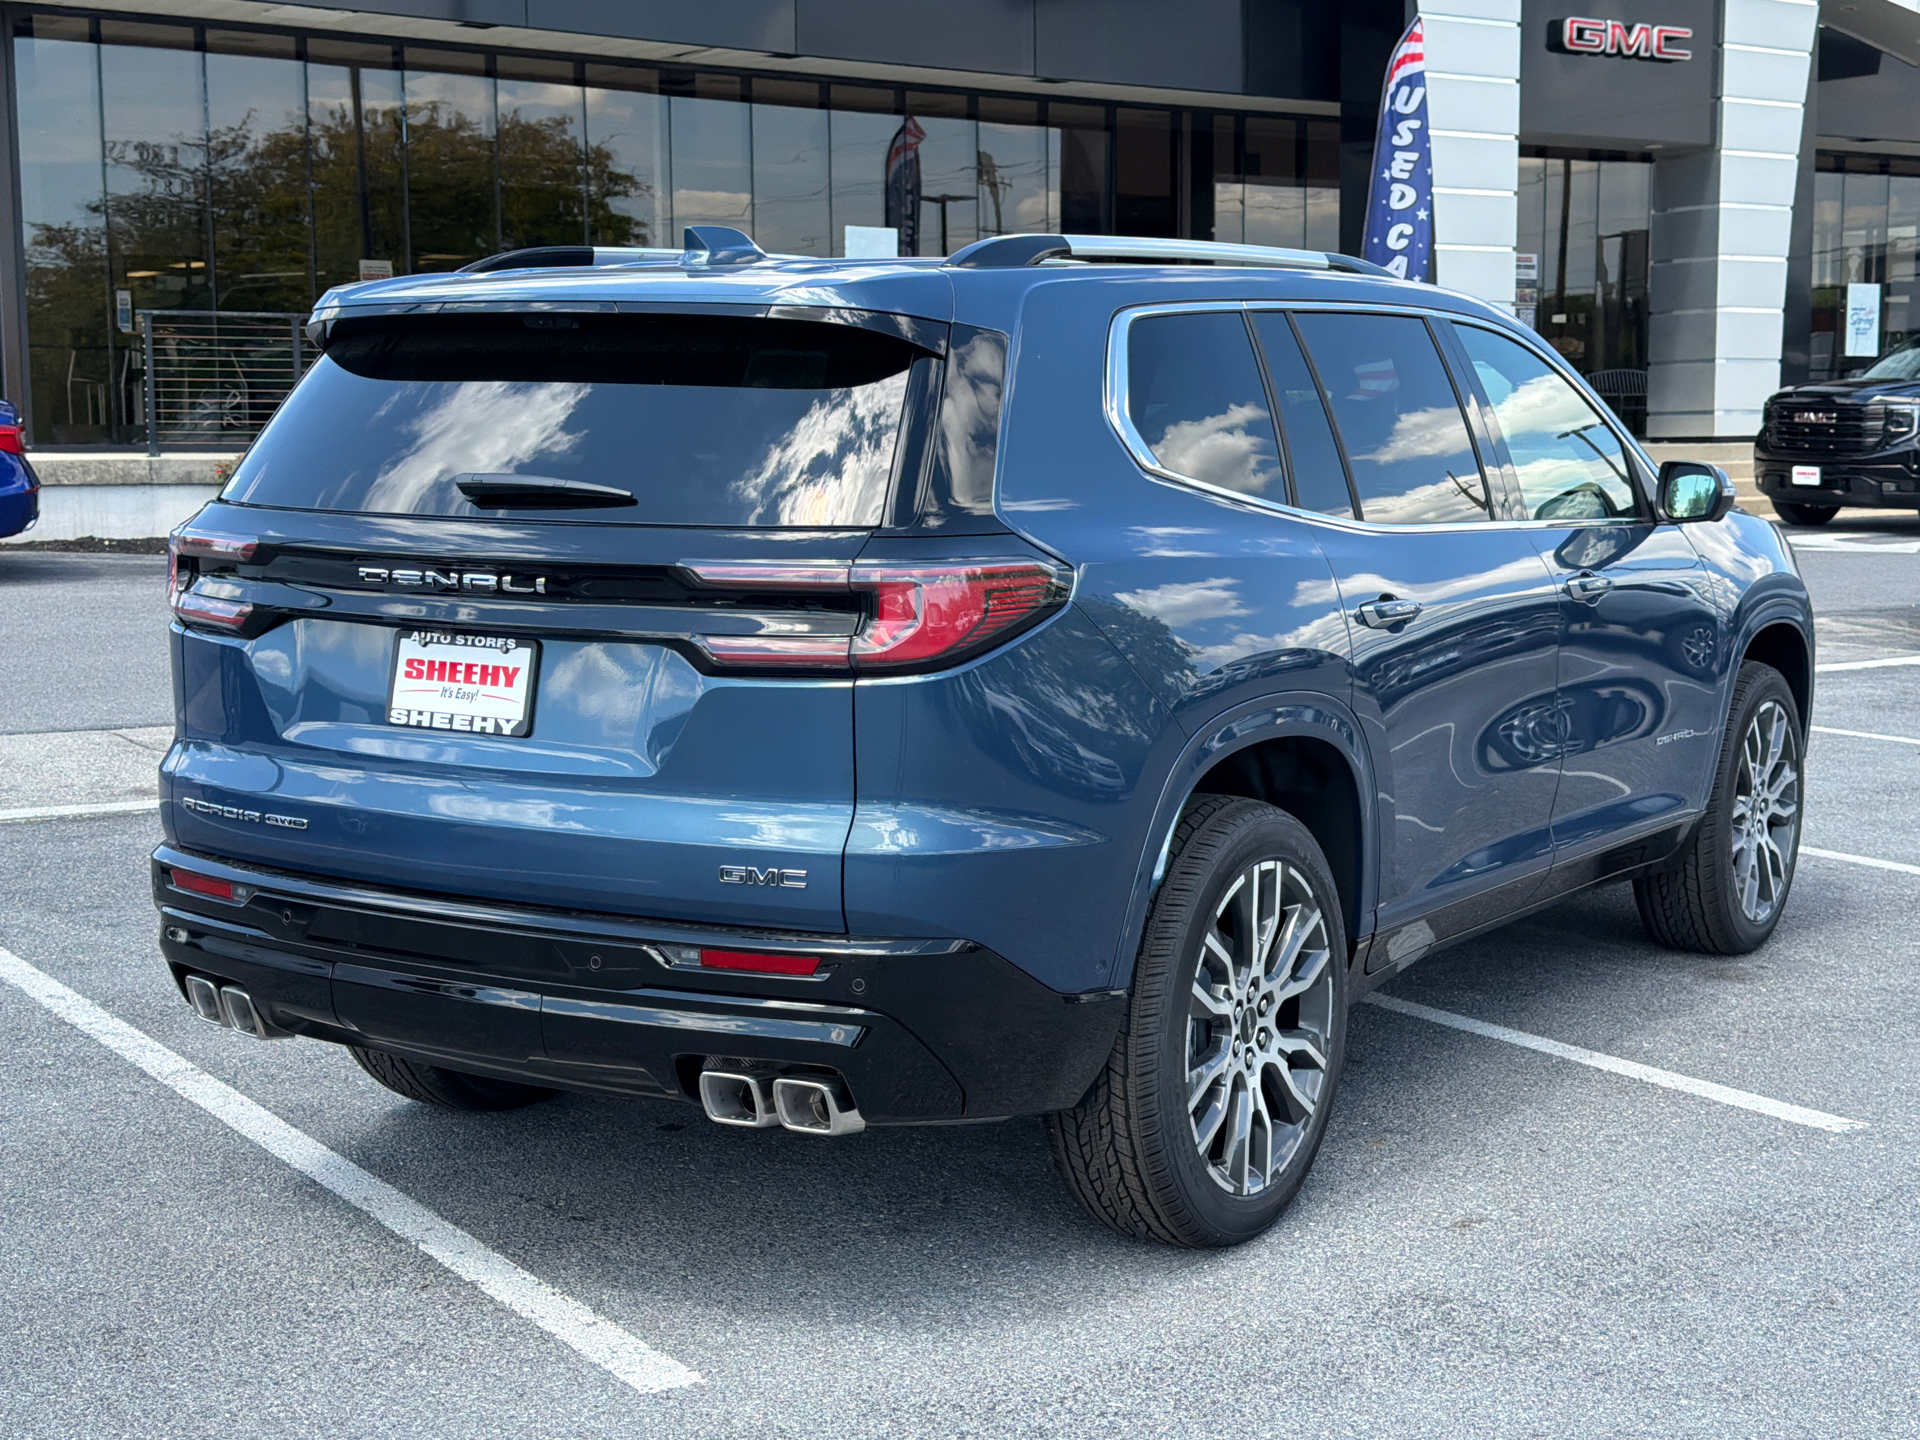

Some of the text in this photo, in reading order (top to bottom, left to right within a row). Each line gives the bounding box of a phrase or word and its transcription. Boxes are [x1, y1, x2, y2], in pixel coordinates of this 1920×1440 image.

[1563, 17, 1693, 60] GMC
[1390, 85, 1426, 210] USED
[358, 567, 547, 595] DENALI
[410, 631, 451, 646] AUTO
[404, 658, 521, 688] SHEEHY
[440, 686, 480, 704] It's Easy!
[389, 708, 520, 735] SHEEHY
[183, 797, 308, 829] ACADIA AWD
[719, 865, 807, 888] GMC
